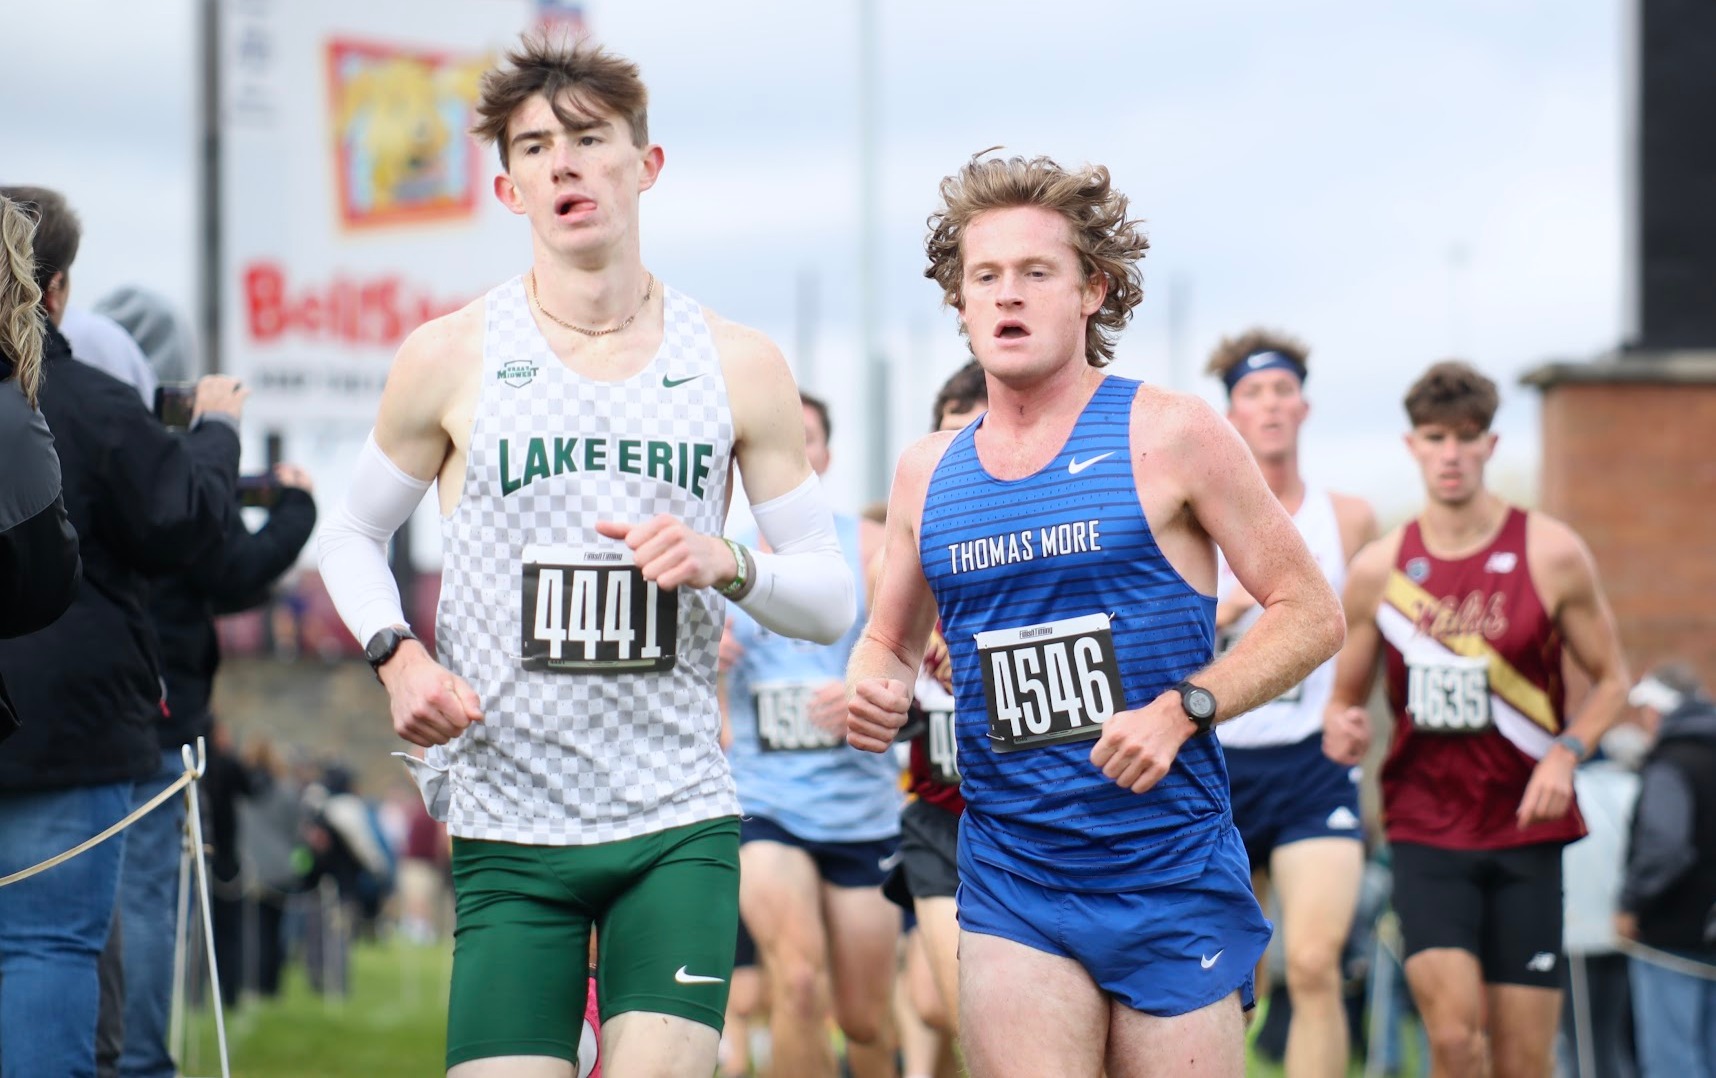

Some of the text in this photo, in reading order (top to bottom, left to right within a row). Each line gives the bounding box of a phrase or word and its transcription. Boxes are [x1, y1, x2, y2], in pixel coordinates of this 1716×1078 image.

[499, 437, 713, 501] LAKE ERIE
[948, 519, 1101, 574] THOMAS MORE
[534, 568, 661, 660] 4441
[990, 636, 1114, 737] 4546
[1408, 667, 1490, 727] 4635
